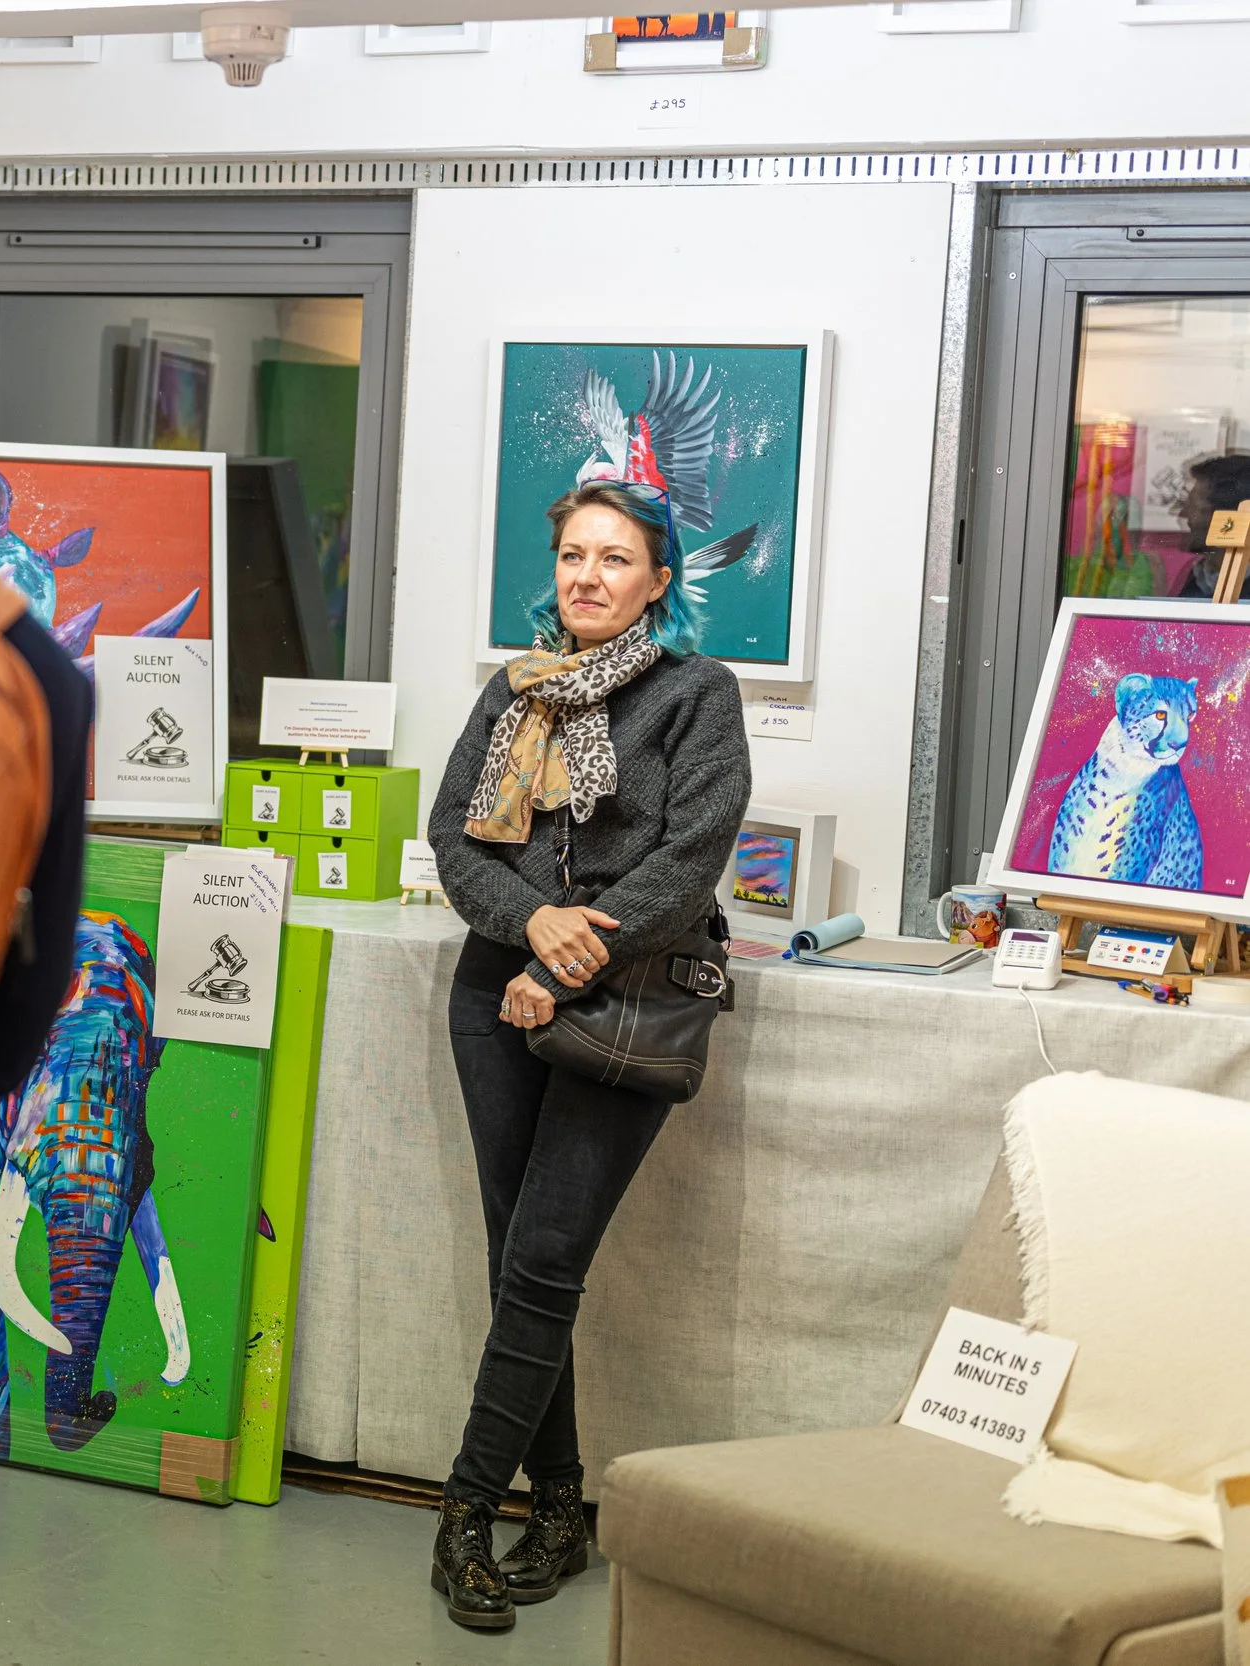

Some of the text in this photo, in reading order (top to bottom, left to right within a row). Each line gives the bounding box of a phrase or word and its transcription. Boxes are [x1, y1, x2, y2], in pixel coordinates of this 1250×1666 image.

[649, 98, 687, 111] £295
[133, 654, 174, 667] SILENT
[126, 671, 181, 684] AUCTION
[117, 774, 139, 782] PLEASE
[140, 775, 152, 783] ASK
[166, 776, 191, 784] DETAILS
[202, 873, 245, 888] SILENT
[250, 864, 282, 897] ELEPHANT
[193, 892, 250, 908] AUCTION
[176, 1007, 251, 1022] PLEASE ASK FOR DETAILS
[958, 1339, 1042, 1376] BACK IN 5
[953, 1361, 1029, 1396] MINUTES
[921, 1398, 1027, 1444] 07403 413893
